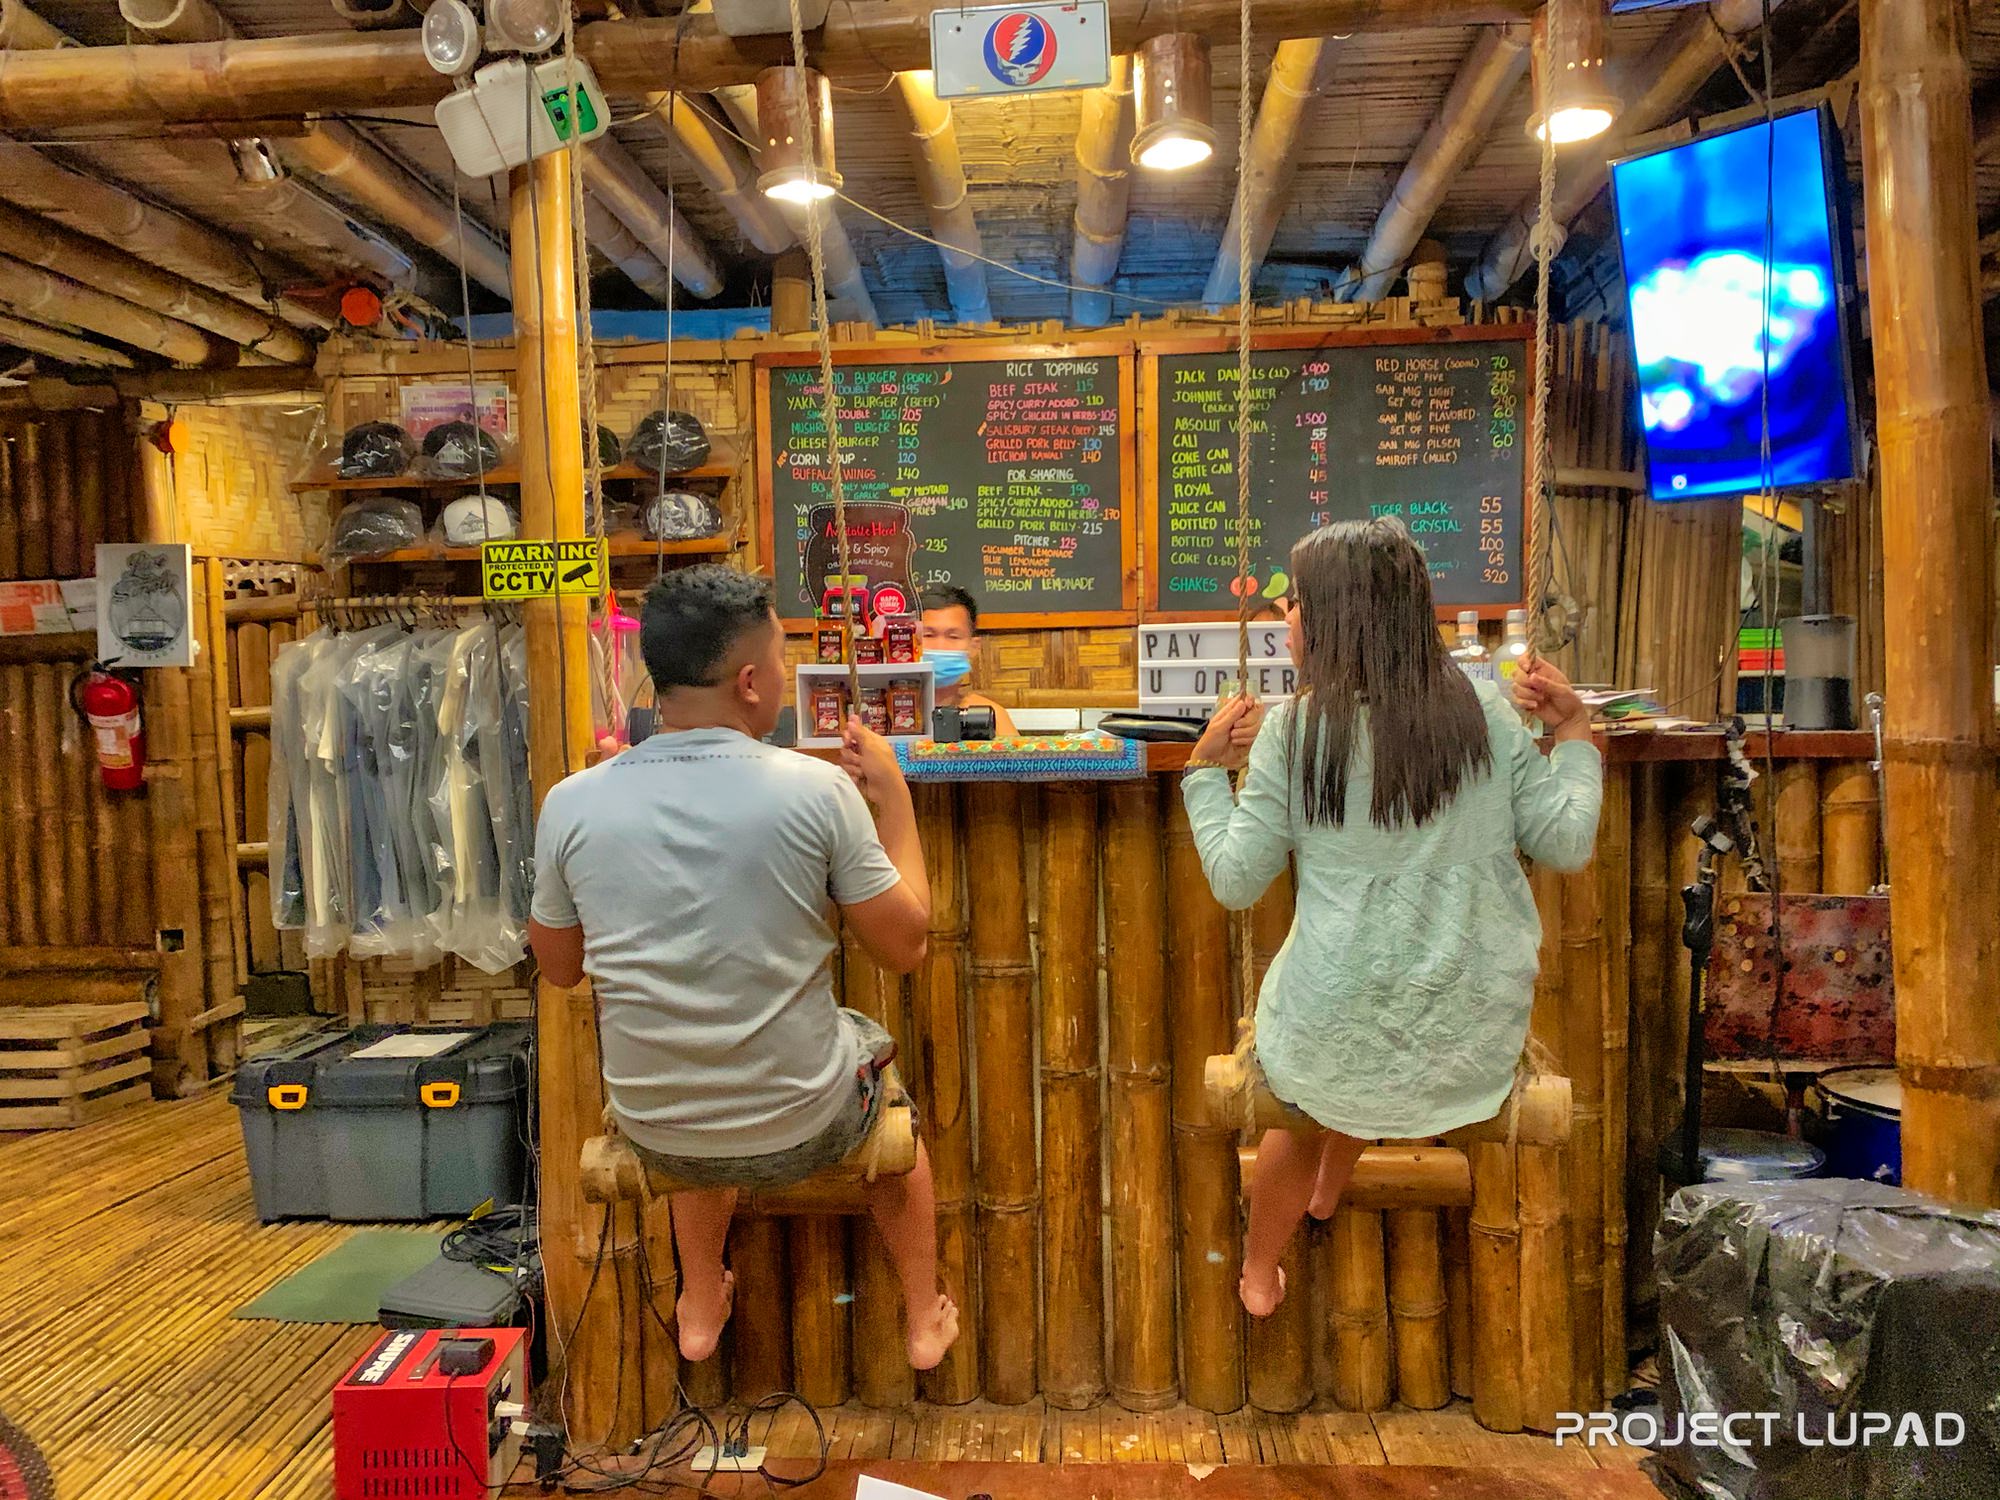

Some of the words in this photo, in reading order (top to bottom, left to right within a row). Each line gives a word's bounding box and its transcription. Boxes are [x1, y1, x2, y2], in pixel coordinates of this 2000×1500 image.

[1006, 363, 1034, 377] RICE
[1044, 361, 1099, 377] TOPPINGS
[1375, 358, 1400, 372] RED
[1405, 358, 1440, 371] HORSE
[1490, 356, 1509, 370] 70
[783, 371, 815, 387] YAKA
[854, 371, 898, 385] BURGER
[903, 370, 939, 384] (PORK)
[1175, 369, 1206, 385] JACK
[1301, 362, 1330, 377] 1900
[1423, 372, 1445, 382] FIVE
[989, 384, 1016, 398] BEEF
[1023, 382, 1059, 396] STEAK
[1076, 379, 1094, 393] 115
[1375, 384, 1395, 394] SAN
[1403, 386, 1422, 397] MIG
[1428, 386, 1456, 397] LIGHT
[1490, 385, 1509, 396] 60
[787, 396, 817, 410] YAKA
[854, 396, 898, 409] BURGER
[904, 395, 940, 408] (BEEF)
[987, 400, 1016, 411] SPICY
[1016, 399, 1047, 410] CURRY
[1047, 397, 1079, 408] ADOBO
[1086, 394, 1105, 407] 110
[1172, 390, 1223, 404] JOHNNIE
[1387, 396, 1405, 408] SET
[1411, 398, 1424, 408] OF
[1429, 398, 1451, 410] FIVE
[985, 411, 1017, 422] SPICY
[1022, 411, 1058, 421] CHICKEN
[1061, 411, 1071, 420] IN
[1174, 417, 1221, 433] ABSOLUT
[1295, 412, 1327, 427] 1500
[1377, 413, 1398, 424] SAN
[1404, 410, 1423, 423] MIG
[1428, 408, 1476, 422] FLAVORED
[1493, 407, 1514, 419] 60
[854, 422, 890, 434] BURGER
[897, 423, 919, 436] 165
[986, 424, 1037, 437] SALISBURY
[1040, 424, 1070, 435] STEAK
[1098, 424, 1116, 437] 145
[1389, 424, 1406, 436] SET
[1409, 425, 1424, 435] OF
[1429, 424, 1451, 434] FIVE
[789, 437, 827, 450] CHEESE
[897, 437, 920, 450] 150
[985, 438, 1022, 450] GRILLED
[1026, 438, 1050, 449] PORK
[1053, 438, 1077, 450] BELLY
[1081, 438, 1103, 450] 130
[1173, 433, 1198, 448] CALI
[1310, 427, 1328, 441] 55
[1377, 440, 1398, 450] SAN
[1404, 440, 1422, 450] MIG
[1426, 438, 1461, 450] PILSEN
[1492, 435, 1514, 449] 60
[789, 454, 820, 466] CORN
[897, 452, 917, 464] 120
[987, 451, 1028, 464] LETCHON
[1080, 450, 1103, 463] 140
[1171, 451, 1200, 465] COKE
[1206, 447, 1230, 461] CAN
[1310, 441, 1328, 454] 45
[1375, 454, 1419, 466] SMIROFF
[843, 468, 877, 480] WINGS
[896, 467, 920, 480] 140
[1007, 468, 1028, 481] FOR
[1029, 467, 1075, 481] SHARING
[1172, 465, 1207, 480] SPRITE
[1211, 462, 1233, 475] CAN
[1310, 453, 1328, 467] 45
[977, 485, 1004, 497] BEEF
[1008, 484, 1043, 496] STEAK
[1173, 482, 1215, 498] ROYAL
[1308, 468, 1328, 485] 45
[907, 496, 948, 507] GERMAN
[977, 497, 1005, 508] SPICY
[1007, 497, 1038, 508] CURRY
[1039, 497, 1074, 509] ADOBO
[1168, 502, 1200, 516] JUICE
[1205, 500, 1227, 514] CAN
[1309, 490, 1329, 505] 45
[1370, 503, 1404, 518] TIGER
[1409, 501, 1450, 516] BLACK
[1479, 496, 1503, 514] 55
[976, 507, 1008, 518] SPICY
[1010, 507, 1051, 519] CHICKEN
[1054, 509, 1066, 519] IN
[976, 518, 1015, 530] GRILLED
[1020, 519, 1046, 532] PORK
[1050, 520, 1077, 532] BELLY
[1082, 521, 1104, 535] 215
[1170, 517, 1218, 532] BOTTLED
[1310, 511, 1331, 527] 45
[1410, 518, 1463, 533] CRYSTAL
[1479, 518, 1504, 535] 55
[1014, 534, 1050, 547] PITCHER
[1059, 537, 1079, 550] 125
[1170, 536, 1215, 548] BOTTLED
[1479, 537, 1505, 552] 100
[488, 544, 599, 562] WARNING
[853, 543, 861, 554] &
[863, 543, 891, 558] Spicy
[981, 544, 1025, 556] CUCUMBER
[1032, 547, 1074, 559] LEMONADE
[875, 559, 895, 569] SAUCE
[983, 555, 1002, 565] BLUE
[1009, 556, 1051, 567] LEMONADE
[1170, 552, 1200, 565] COKE
[488, 562, 541, 571] PROTECTED
[984, 566, 1005, 577] PINK
[1010, 567, 1057, 578] LEMONADE
[489, 571, 556, 591] CCTV
[926, 569, 951, 584] 150
[1482, 568, 1509, 584] 320
[985, 577, 1033, 592] PASSION
[1041, 576, 1096, 592] LEMONADE
[1168, 576, 1219, 592] SHAKES
[1145, 632, 1201, 659] PAY
[1149, 669, 1163, 694] U
[358, 1333, 416, 1383] SHURE
